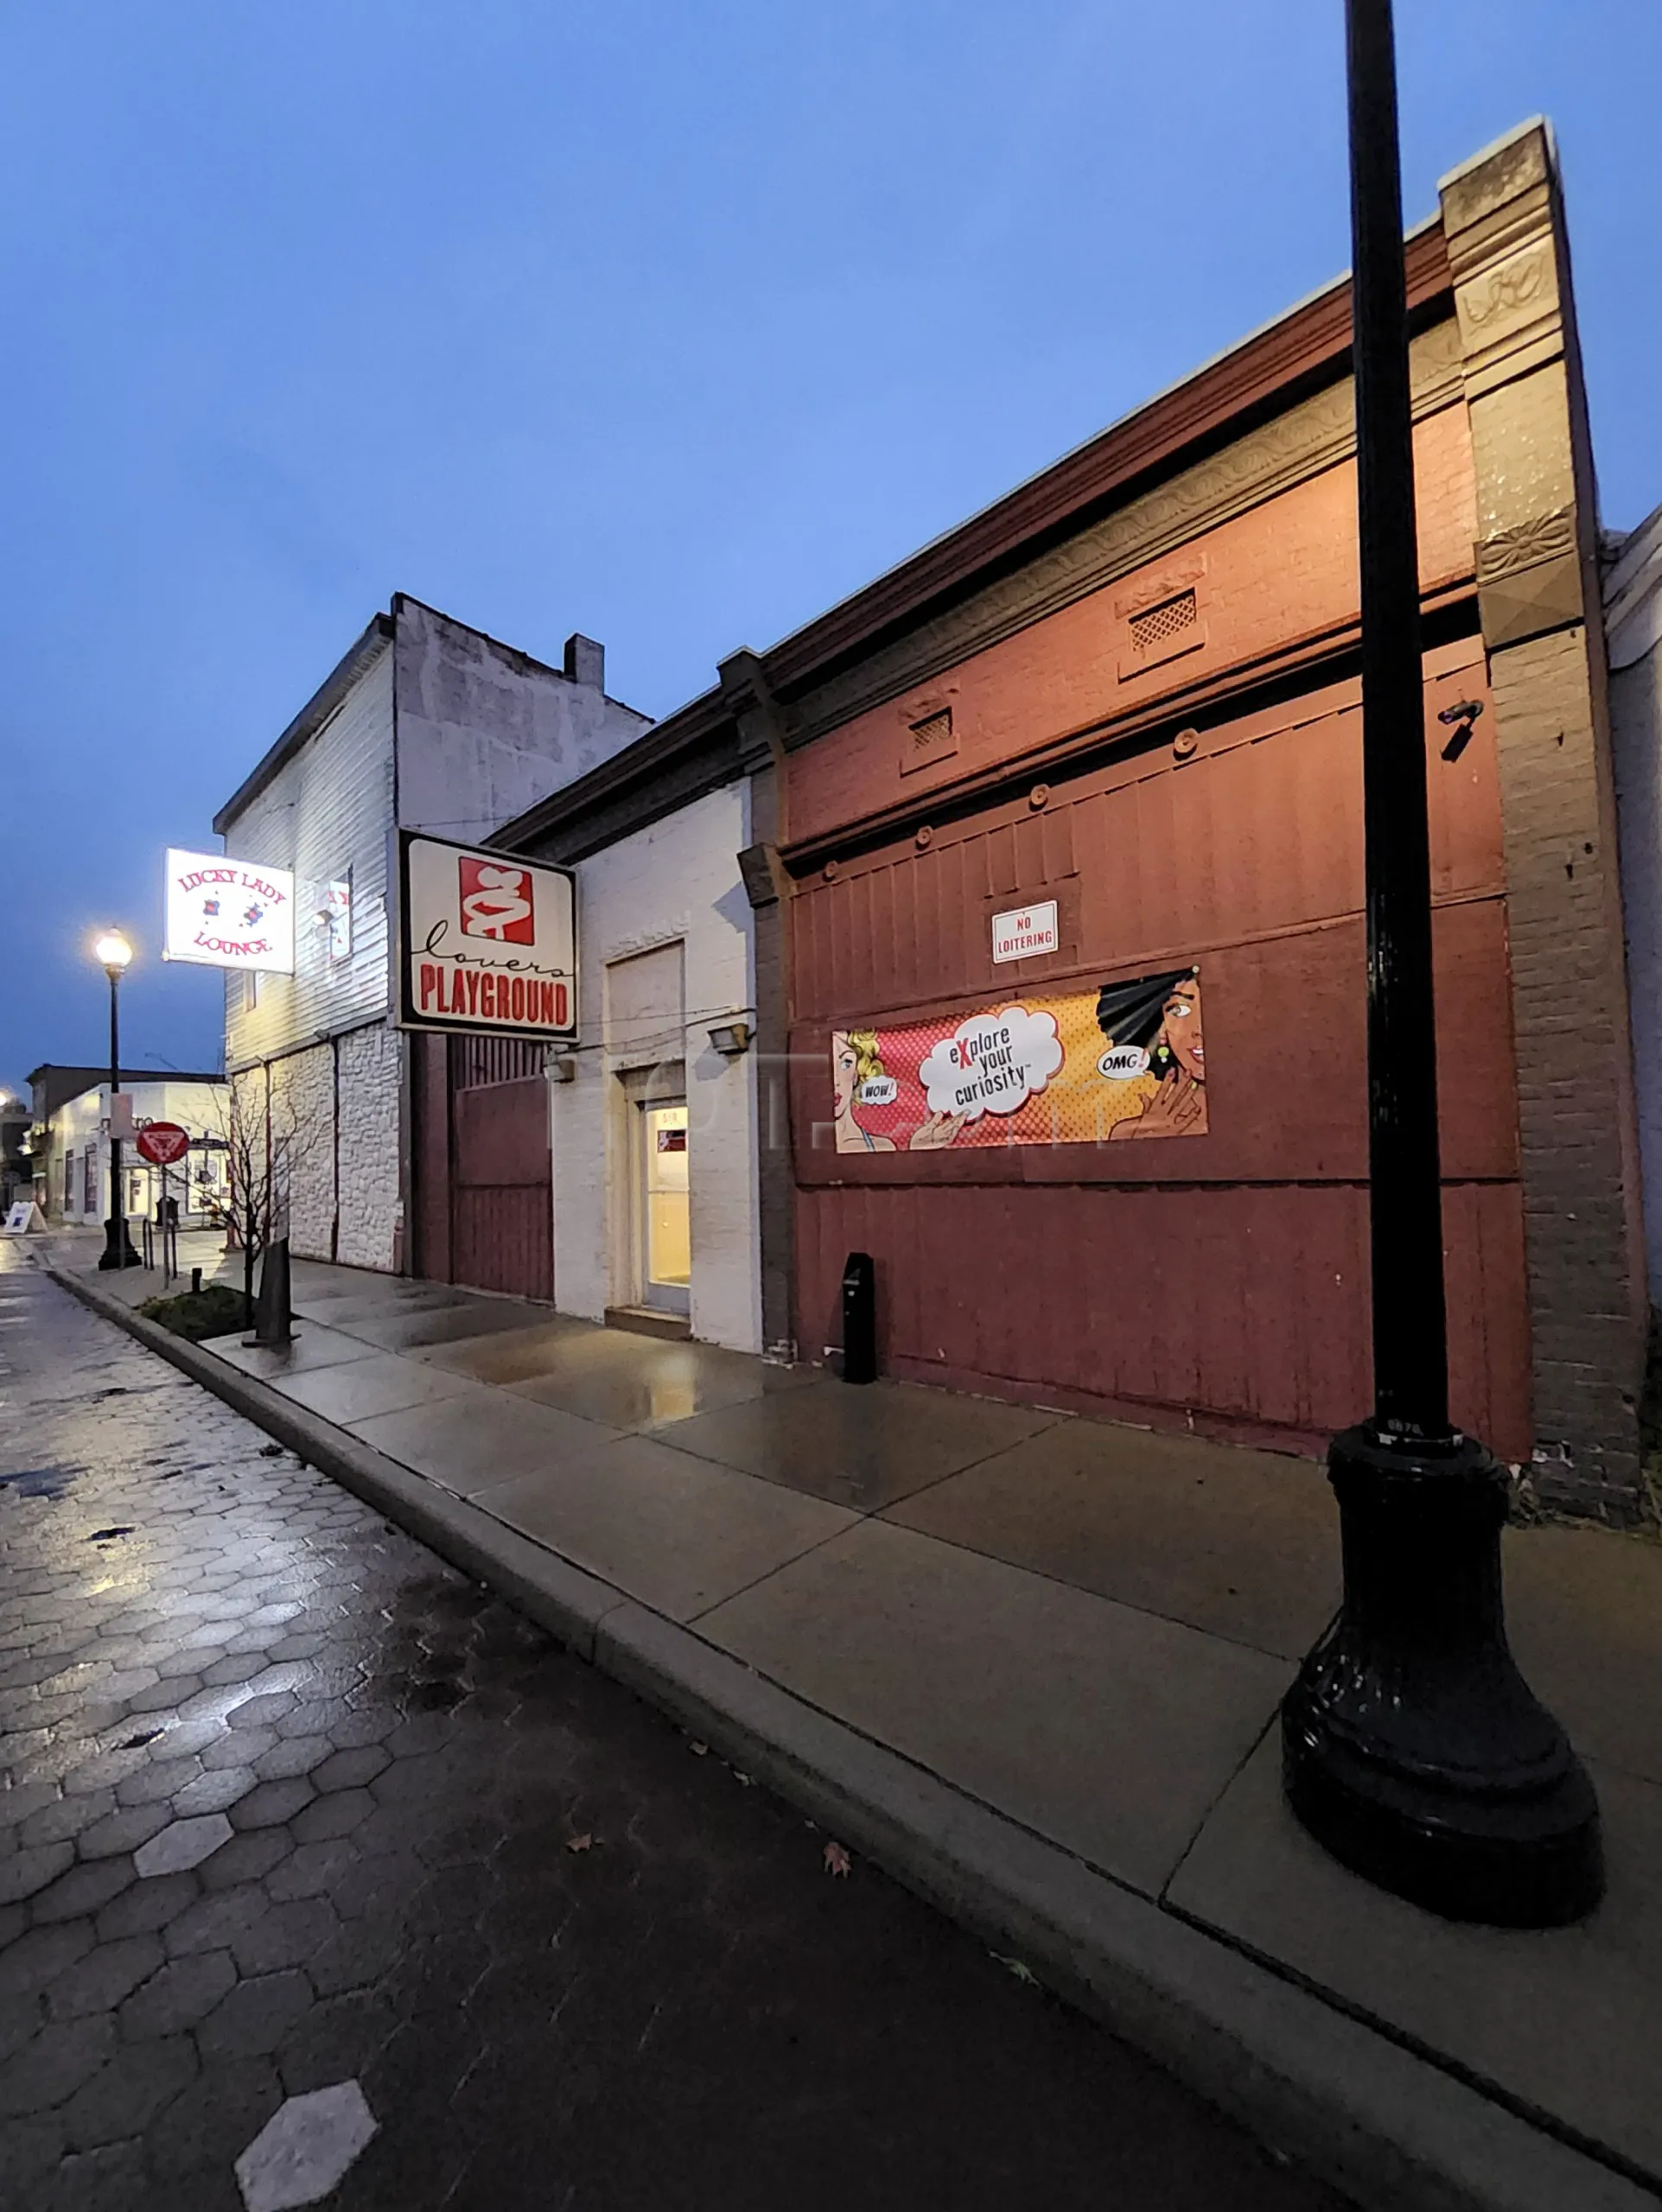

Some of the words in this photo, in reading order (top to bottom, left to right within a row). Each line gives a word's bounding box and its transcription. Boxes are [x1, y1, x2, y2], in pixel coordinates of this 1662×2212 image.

[178, 868, 238, 893] LUCKY
[241, 873, 286, 905] LADY
[1016, 916, 1032, 931] NO
[194, 931, 273, 955] LOUNGE
[411, 919, 574, 977] lovers
[998, 931, 1053, 954] LOITERING
[420, 963, 567, 1027] PLAYGROUND
[950, 1027, 1010, 1070] eXplore
[978, 1045, 1013, 1078] your
[1102, 1047, 1149, 1071] OMG!
[865, 1082, 895, 1098] WOW!
